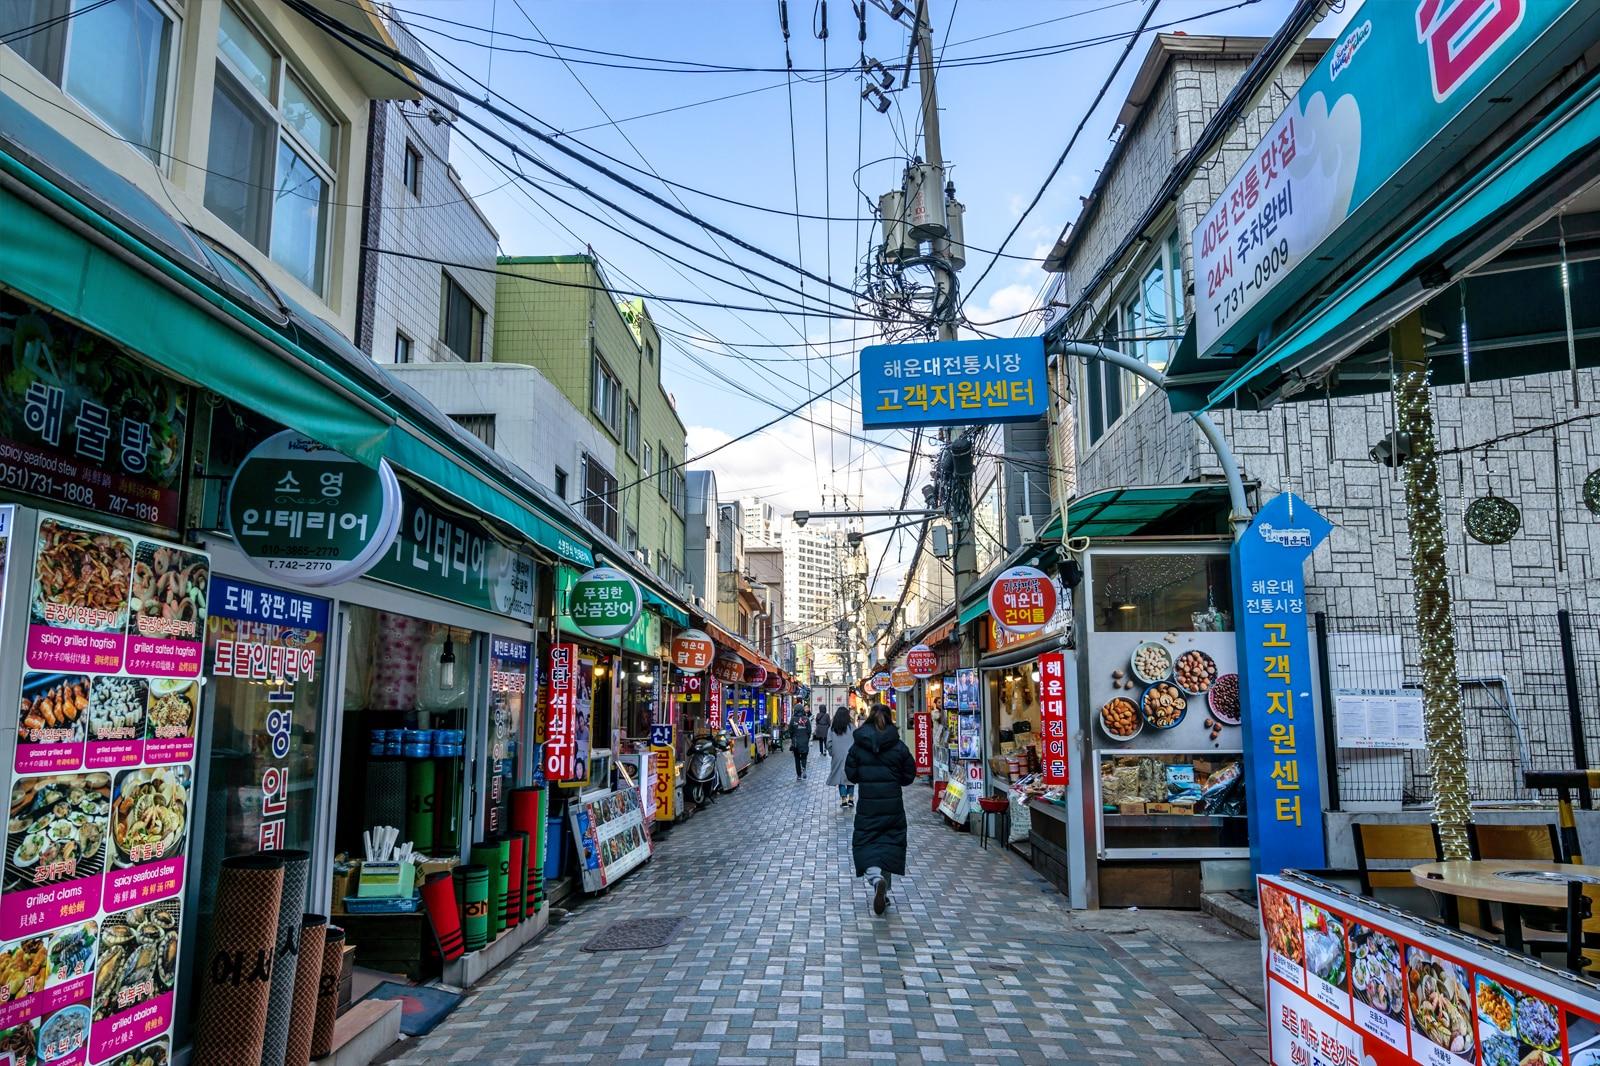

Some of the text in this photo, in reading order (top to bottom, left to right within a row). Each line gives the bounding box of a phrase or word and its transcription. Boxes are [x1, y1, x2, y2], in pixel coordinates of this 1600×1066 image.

[1201, 117, 1297, 260] 40년 전통 맛집
[1208, 179, 1293, 299] 24시 주차완비
[1214, 238, 1289, 327] T.731-0909
[883, 353, 1021, 379] 해운대전통시장
[876, 379, 1035, 412] 고객지원센터
[25, 381, 152, 474] 해물탕
[0, 444, 77, 481] spicy seafood stew
[109, 494, 158, 522] 747-1818
[242, 510, 368, 541] 인테리어
[413, 507, 485, 590] 인테리어
[1280, 536, 1311, 546] 해운대
[268, 559, 332, 572] T.742-2770
[584, 586, 623, 600] 푸짐한
[1004, 593, 1043, 608] 해운대
[1252, 579, 1294, 595] 해운대
[573, 601, 633, 618] 산곰장어
[1006, 608, 1045, 624] 건어물
[1246, 598, 1303, 614] 전통시장
[40, 632, 61, 647] spicy
[63, 633, 87, 647] grilled
[134, 642, 154, 654] grilled
[154, 644, 174, 655] salted
[213, 639, 316, 683] 토탈인테리어
[1262, 623, 1303, 828] 고객지원센터
[33, 861, 77, 883] 조개구이
[113, 864, 175, 888] spicy seafood stew
[26, 886, 82, 909] grilled clams
[117, 977, 155, 1009] 전복구이
[111, 1005, 158, 1033] grilled abalone
[1281, 1004, 1299, 1039] 모든
[1300, 1018, 1319, 1053] 메뉴
